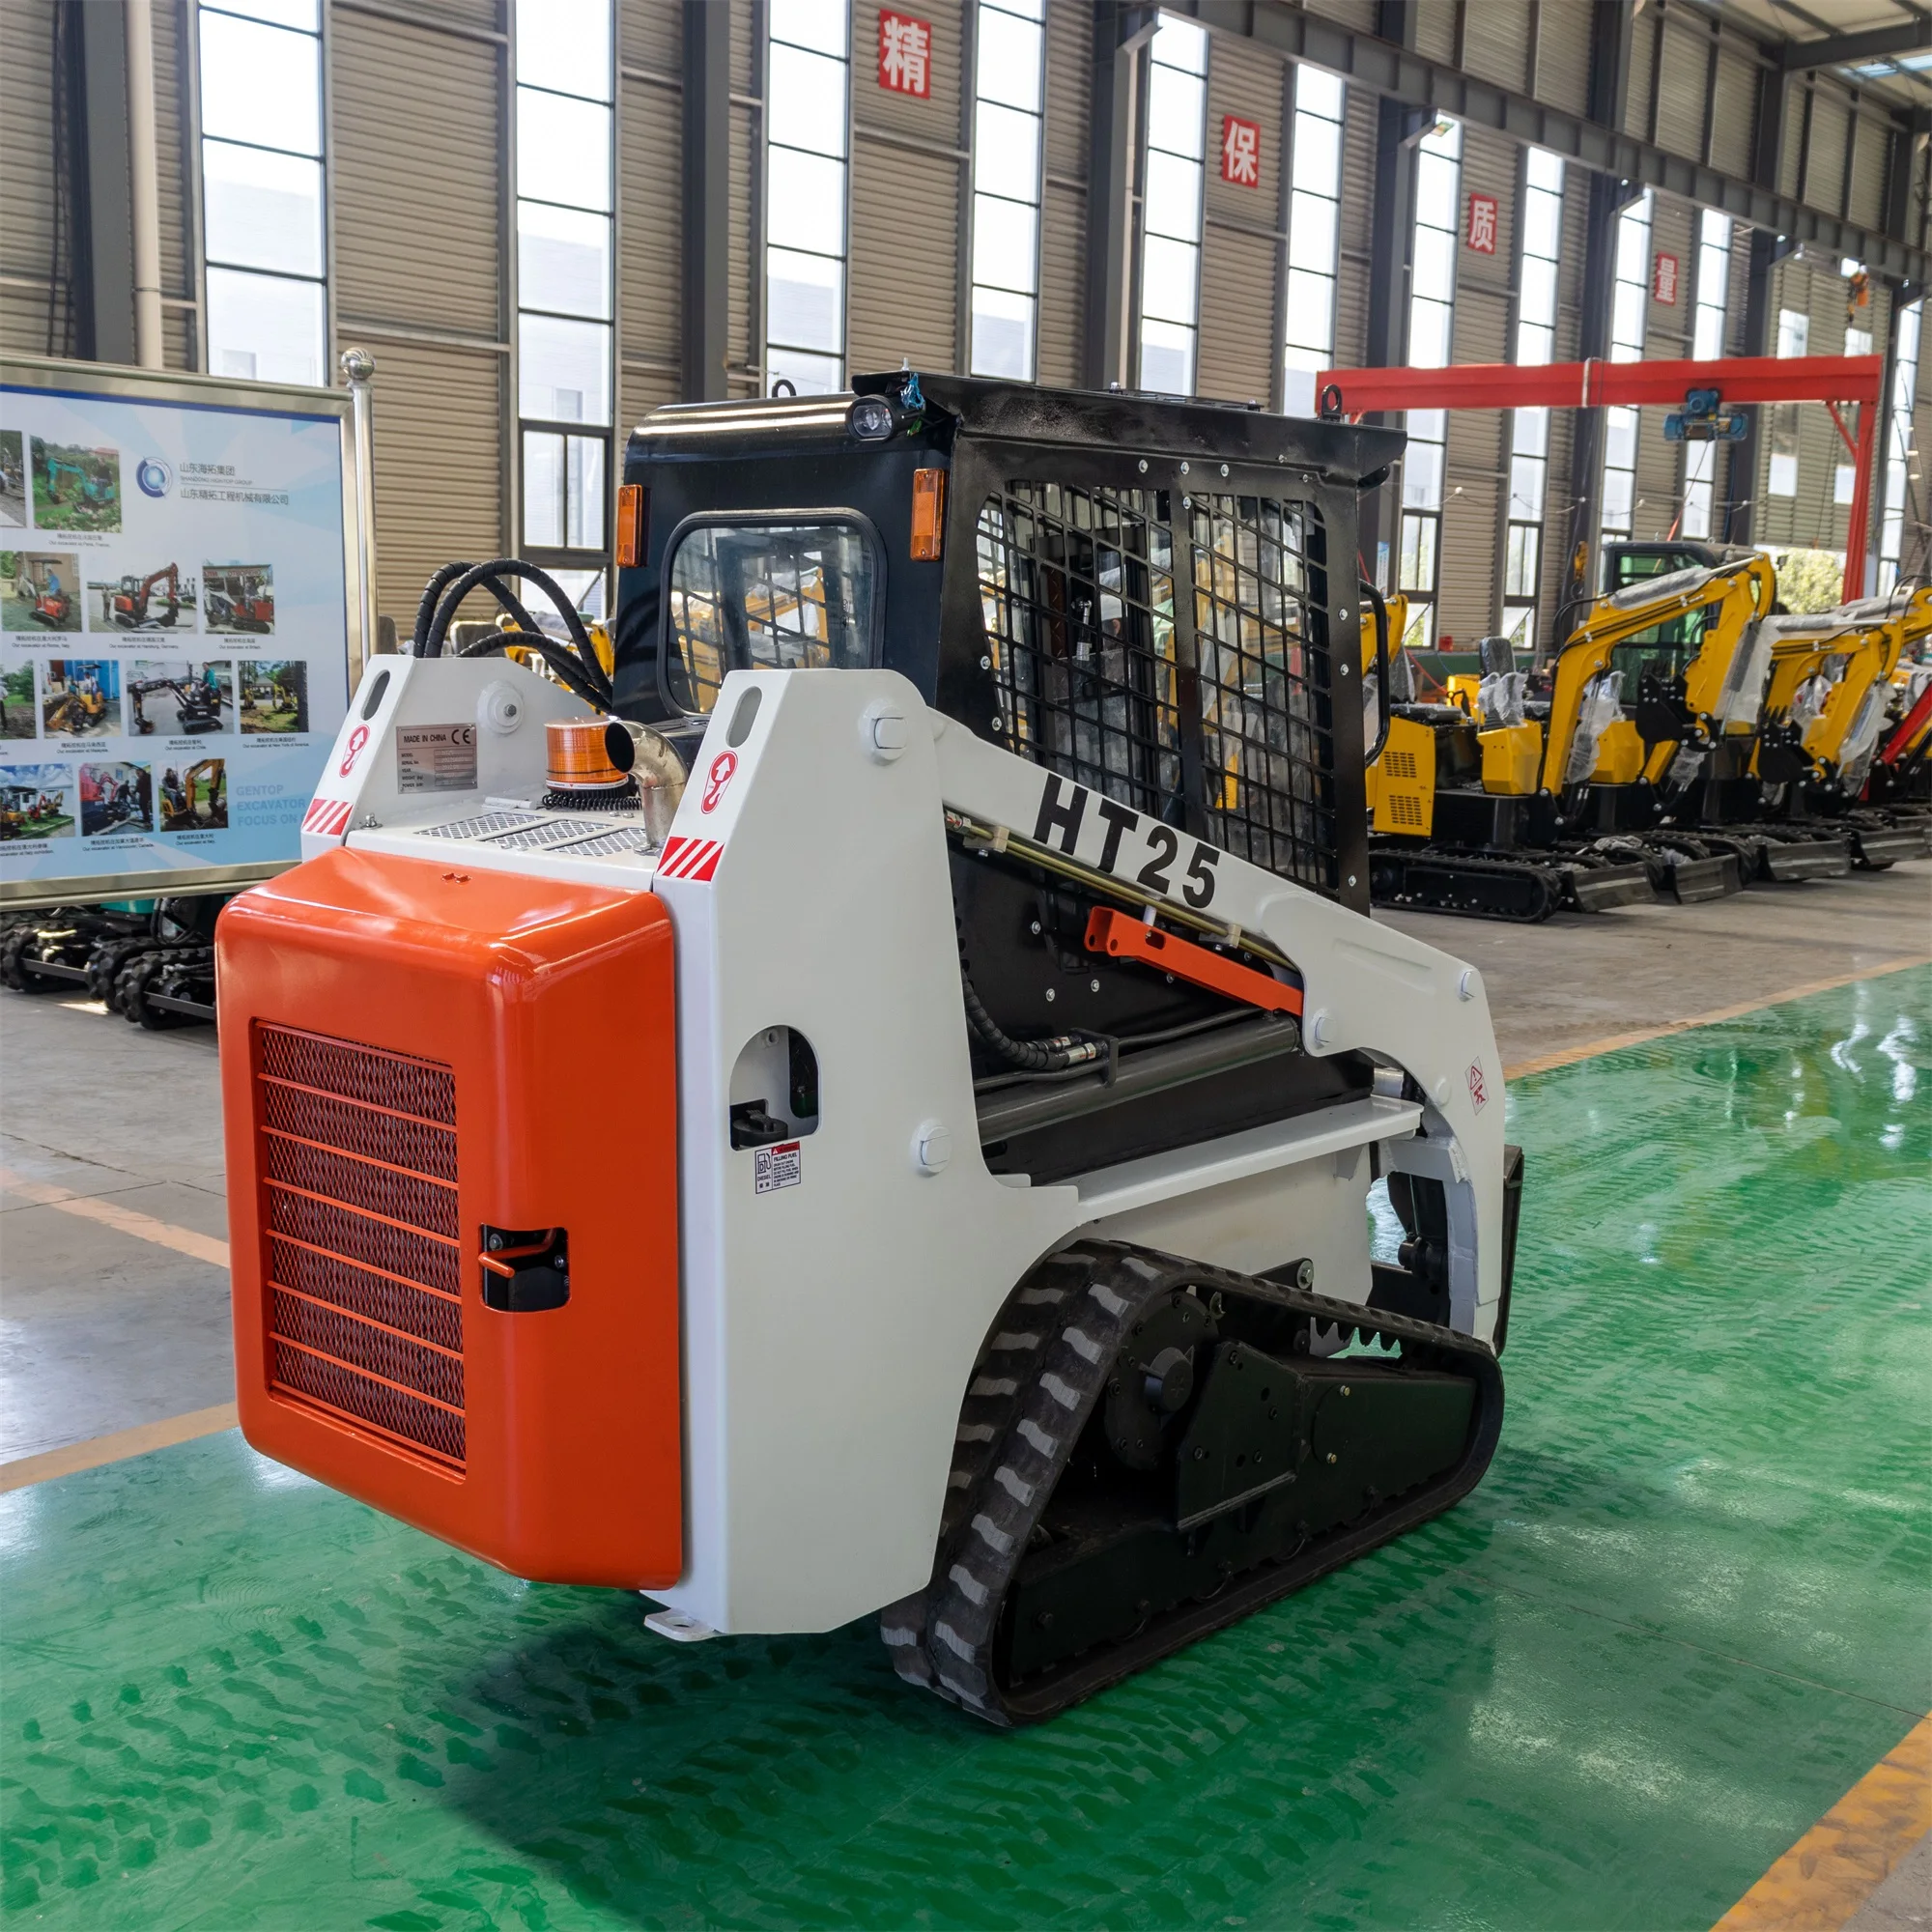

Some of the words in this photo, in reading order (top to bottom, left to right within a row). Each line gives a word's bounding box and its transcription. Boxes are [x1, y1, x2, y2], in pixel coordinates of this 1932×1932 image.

[883, 15, 928, 93] 精
[1225, 121, 1257, 183] 保
[1470, 200, 1495, 251] 质
[1656, 257, 1677, 301] 量
[180, 463, 235, 476] 山东海拓集团
[451, 728, 470, 745] CE
[236, 784, 284, 797] GENTOP
[237, 798, 306, 811] EXCAVATOR
[238, 814, 277, 827] FOCUS
[280, 813, 298, 824] ON
[1033, 772, 1220, 909] HT25
